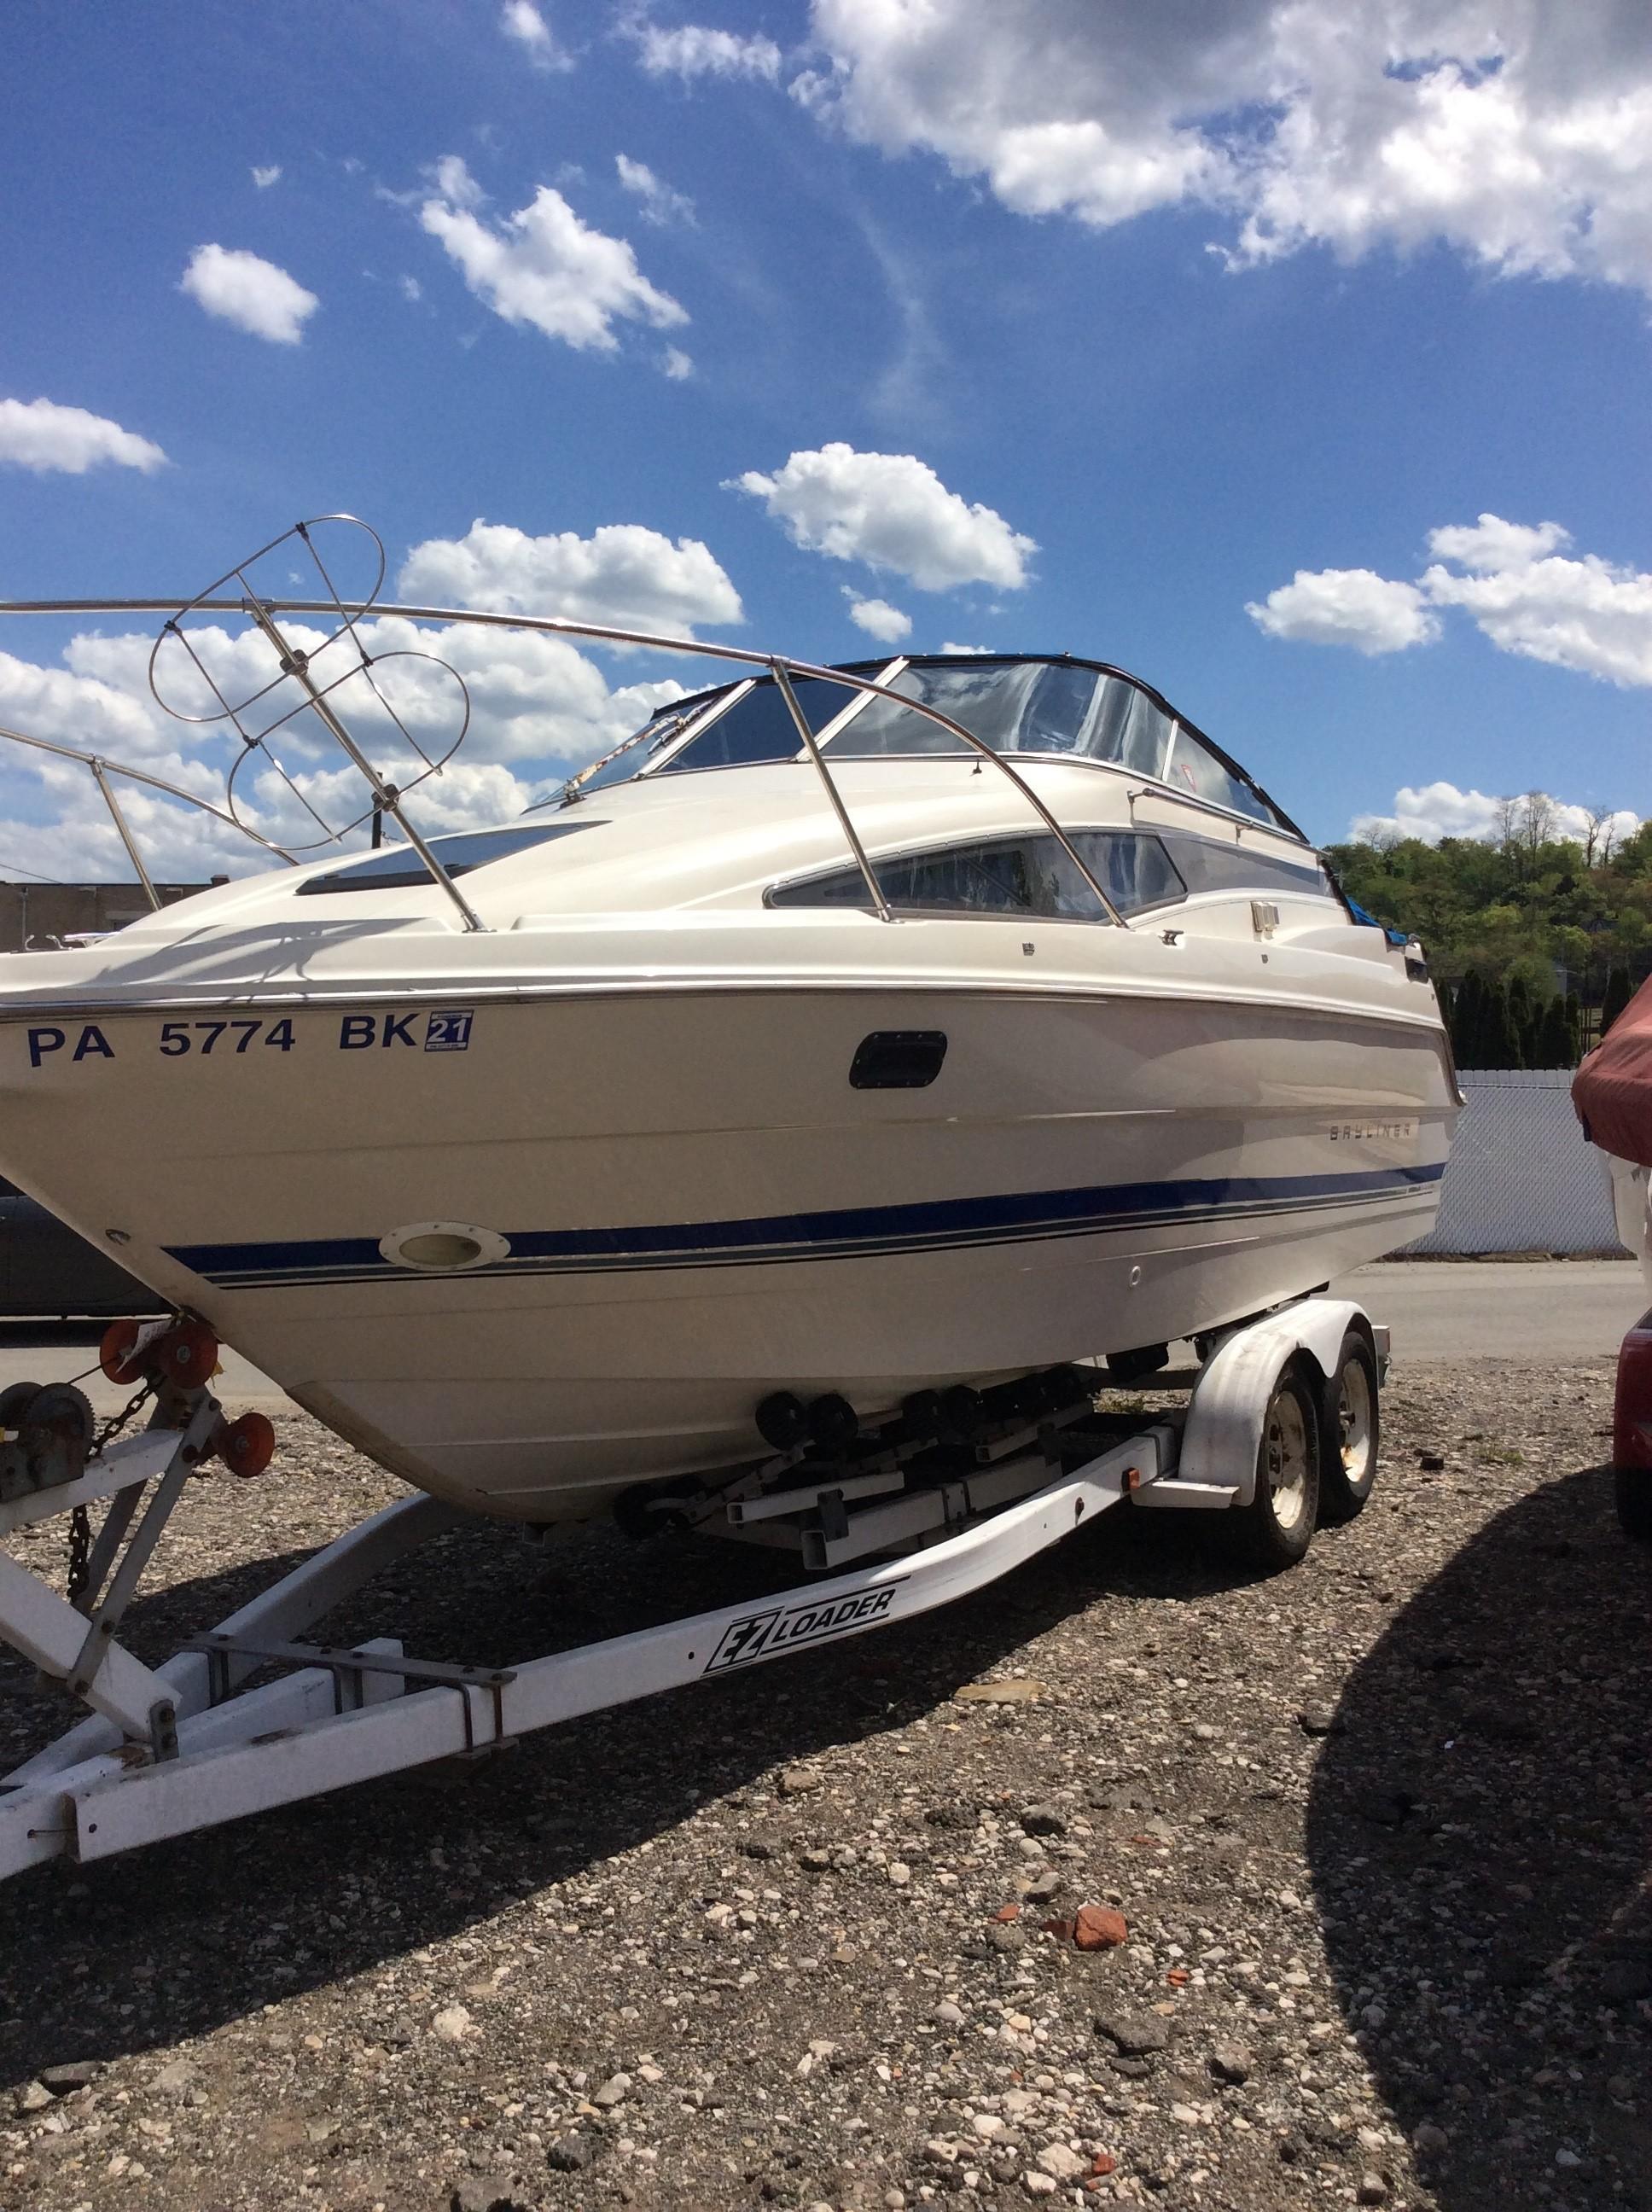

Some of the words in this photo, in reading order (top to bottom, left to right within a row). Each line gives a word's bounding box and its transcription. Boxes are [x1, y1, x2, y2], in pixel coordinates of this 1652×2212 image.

[27, 1026, 115, 1067] PA
[160, 1019, 295, 1056] 5774
[339, 1014, 419, 1049] BK
[428, 1018, 467, 1042] 21
[1329, 1124, 1411, 1140] BAYLINER
[710, 1611, 782, 1667] EZ
[771, 1589, 896, 1643] LOADER
